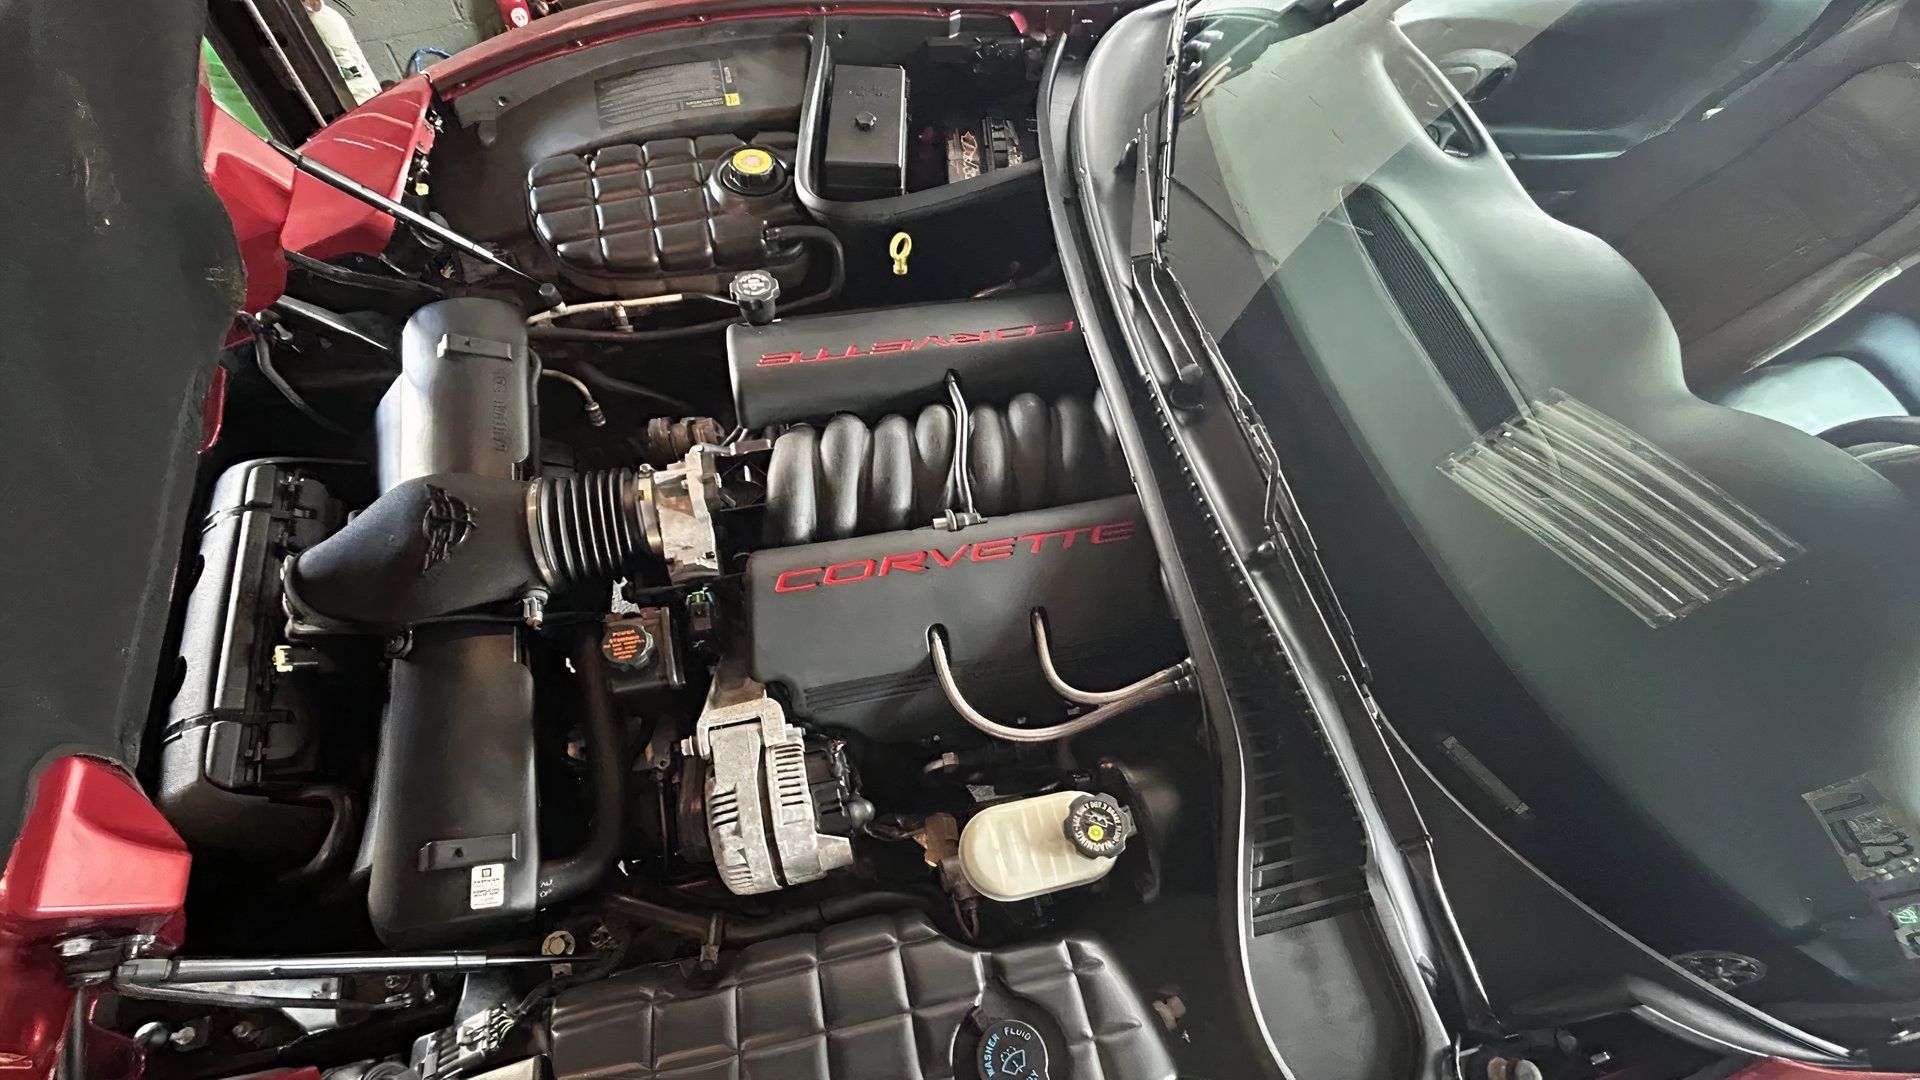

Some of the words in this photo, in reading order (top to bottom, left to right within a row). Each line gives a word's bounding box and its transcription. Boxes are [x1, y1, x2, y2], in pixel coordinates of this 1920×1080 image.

[757, 320, 1074, 367] CORVETTE
[774, 520, 1135, 593] CORVETTE
[1075, 830, 1114, 851] WARNING
[984, 1033, 1000, 1078] WASHER
[1004, 1026, 1032, 1041] FLUID
